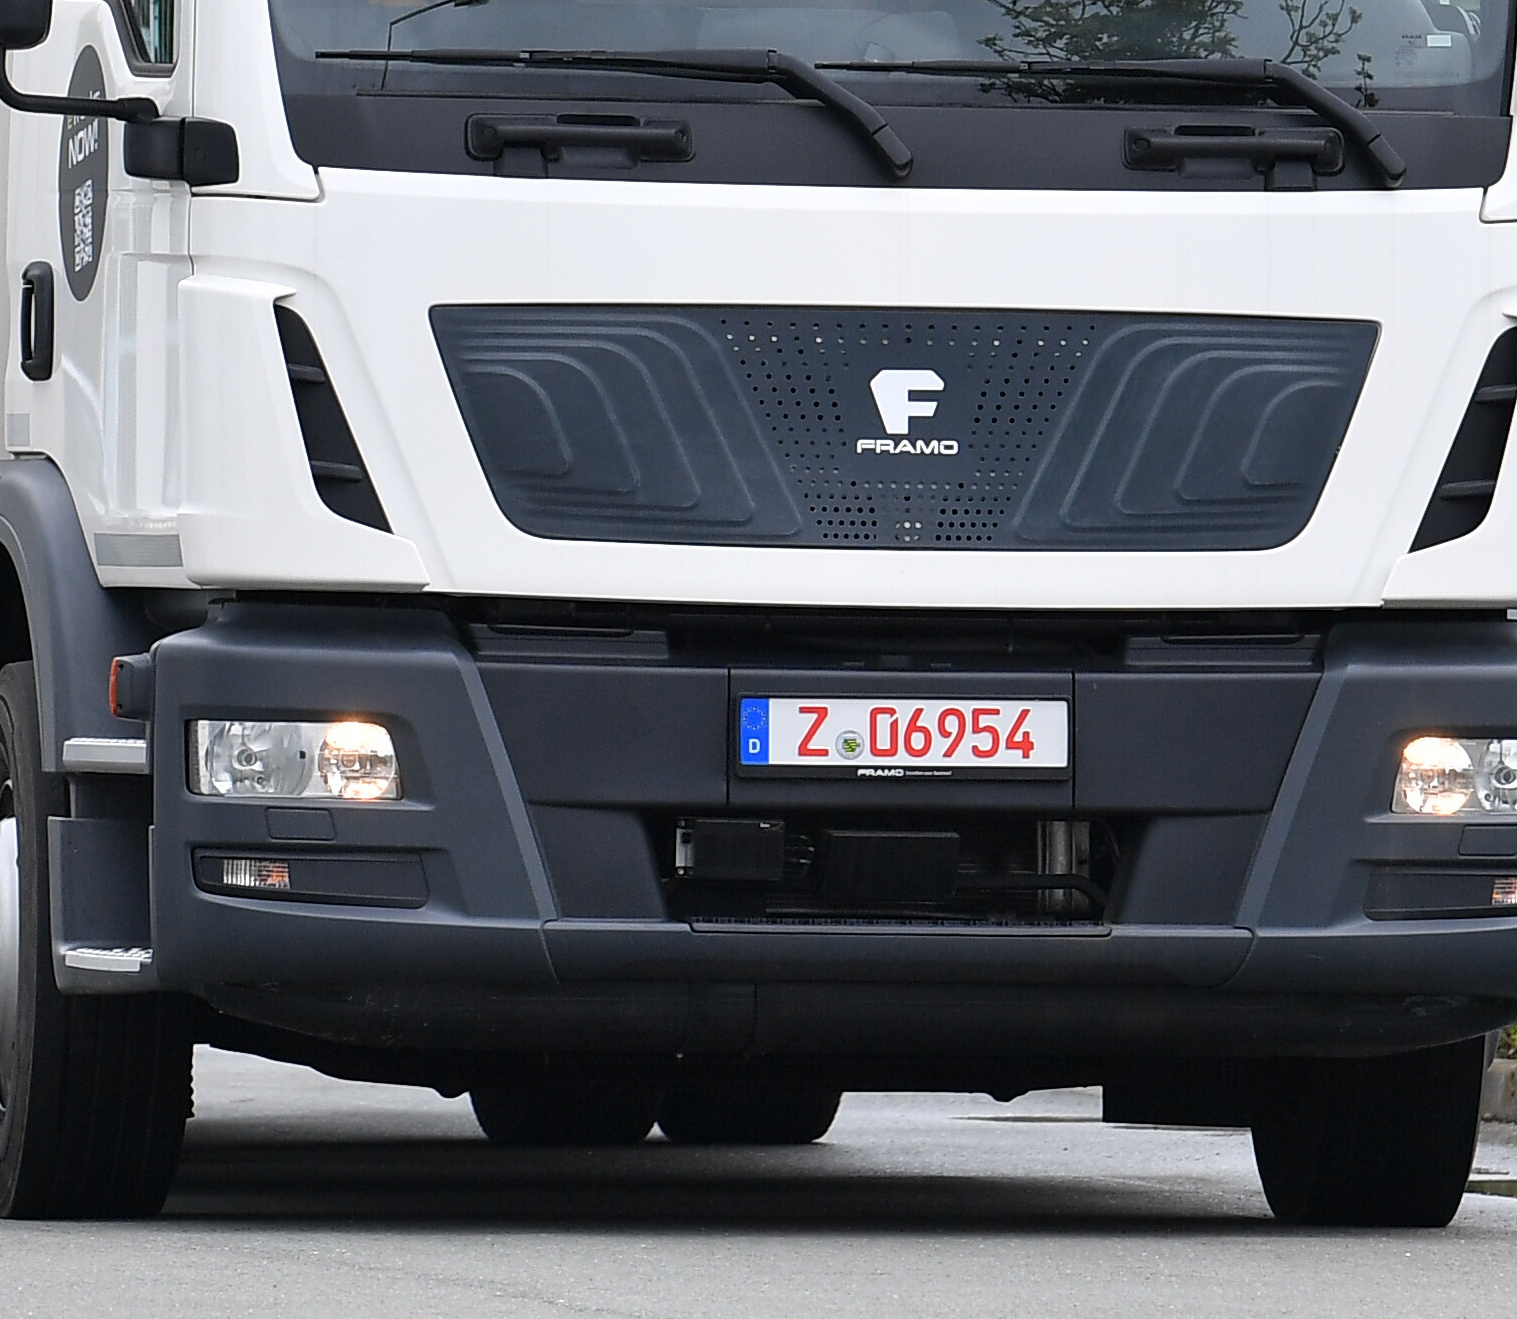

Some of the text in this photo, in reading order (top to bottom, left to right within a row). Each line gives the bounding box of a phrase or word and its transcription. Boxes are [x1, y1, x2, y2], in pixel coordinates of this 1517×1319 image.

[67, 117, 99, 170] NOW!
[856, 439, 959, 455] FRAMO
[797, 706, 1035, 759] Z 06954
[748, 738, 761, 754] D
[857, 768, 904, 777] FRAMO
